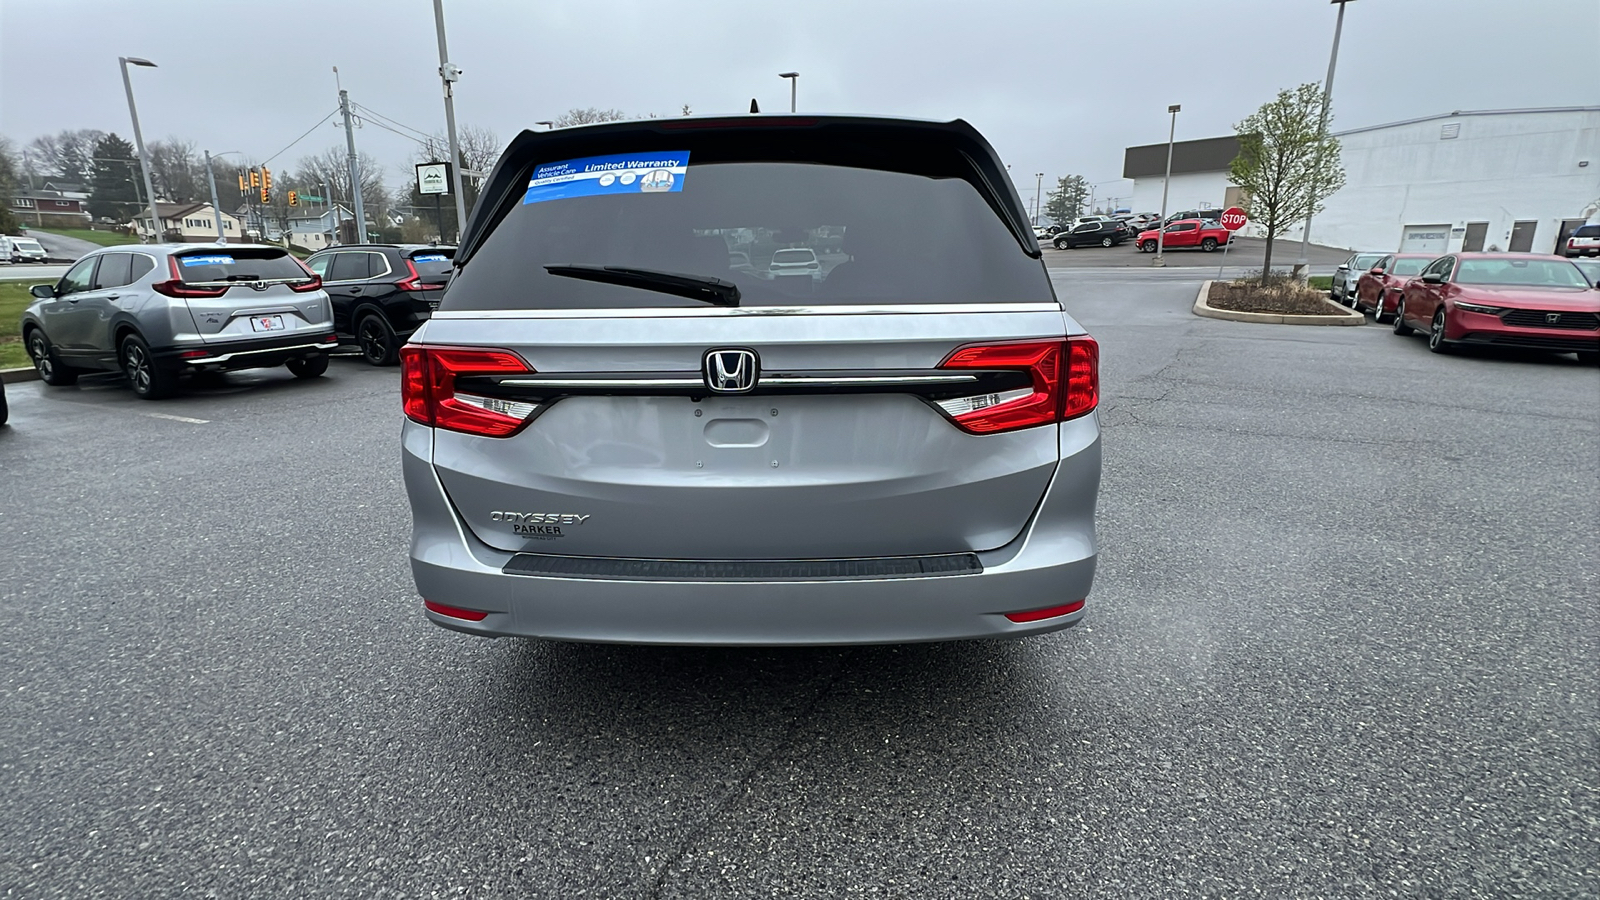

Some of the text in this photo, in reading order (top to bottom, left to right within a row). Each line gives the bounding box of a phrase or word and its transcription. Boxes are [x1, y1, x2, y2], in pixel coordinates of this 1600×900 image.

[538, 163, 569, 173] Assurant
[584, 159, 680, 172] Limited Warranty
[537, 169, 561, 179] Vehicle
[552, 175, 575, 183] Certified
[1222, 214, 1246, 224] STOP
[490, 510, 591, 525] ODYSSEY
[513, 524, 561, 534] PARKER
